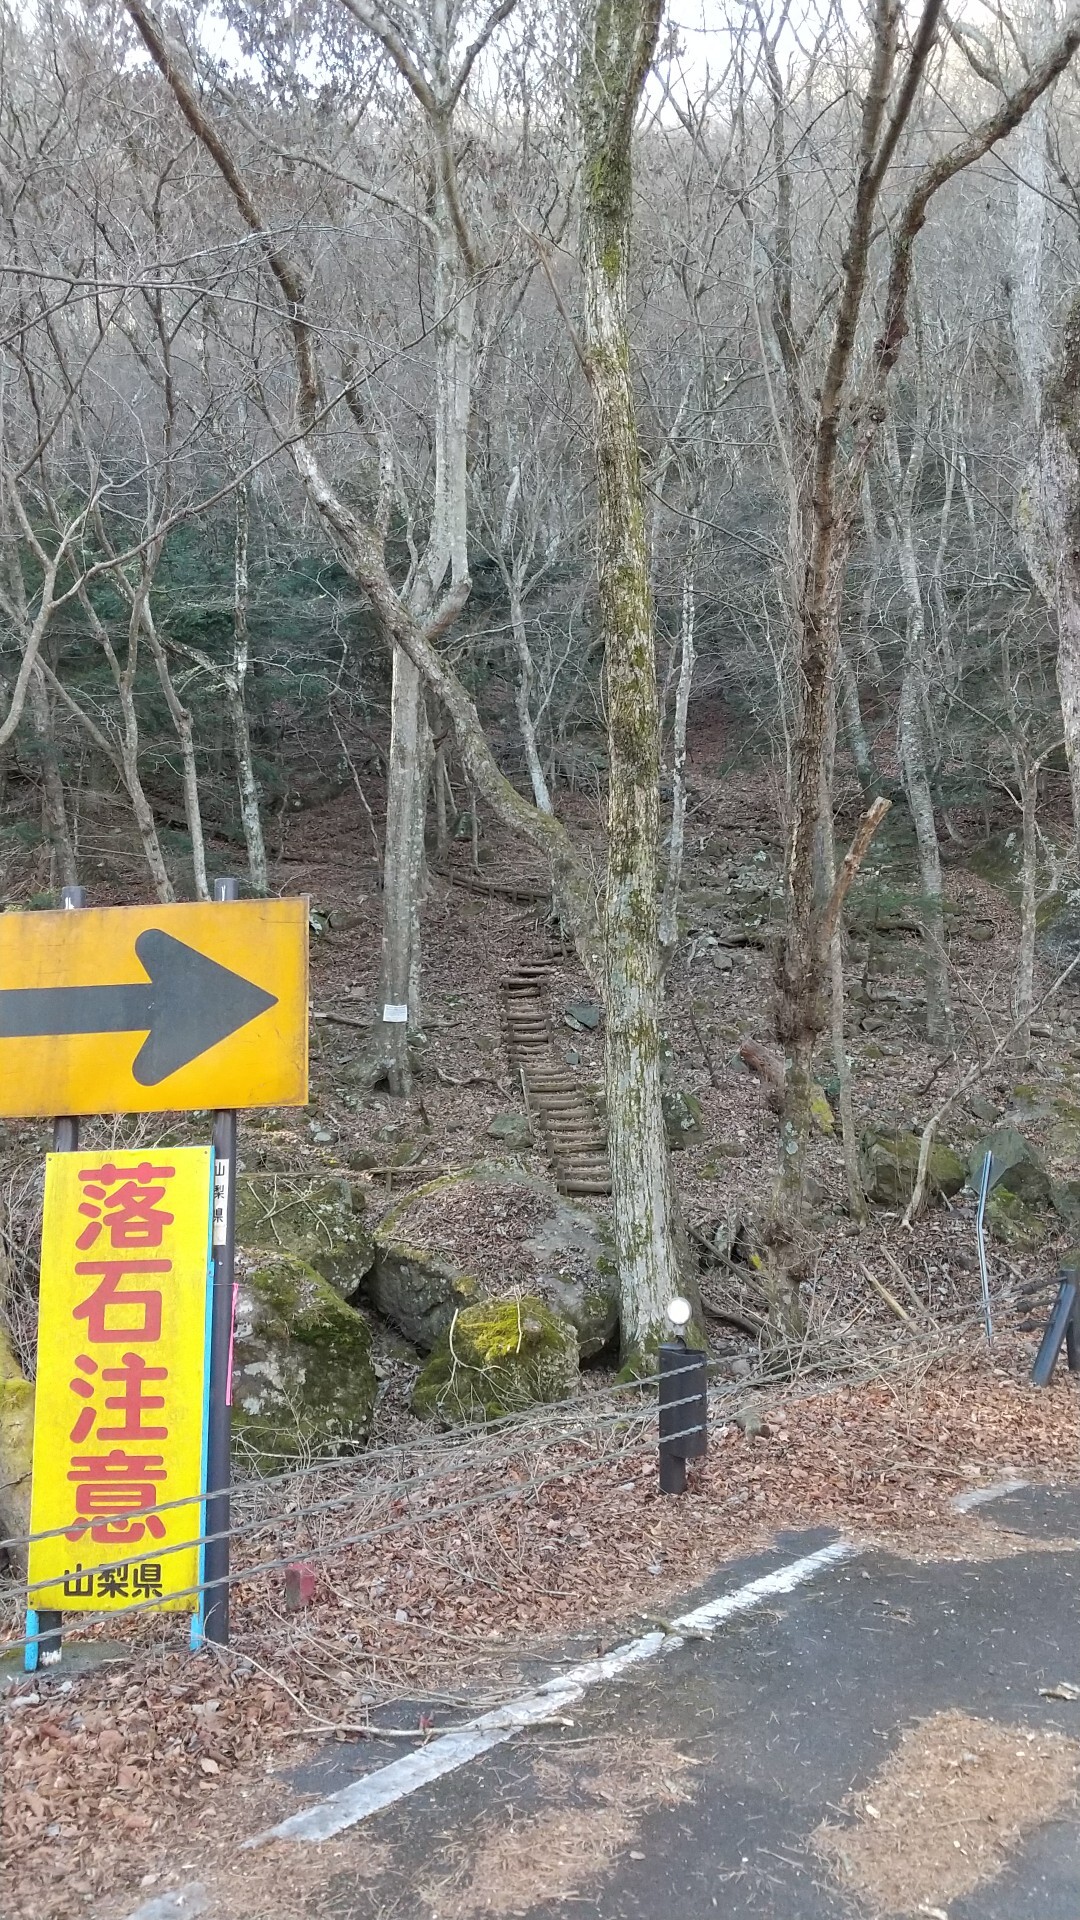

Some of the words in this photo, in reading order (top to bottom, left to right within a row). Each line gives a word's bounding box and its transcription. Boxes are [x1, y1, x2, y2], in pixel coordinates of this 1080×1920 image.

[213, 1161, 226, 1223] 山梨県
[67, 1162, 176, 1545] 落石注意
[63, 1563, 163, 1599] 山梨県
